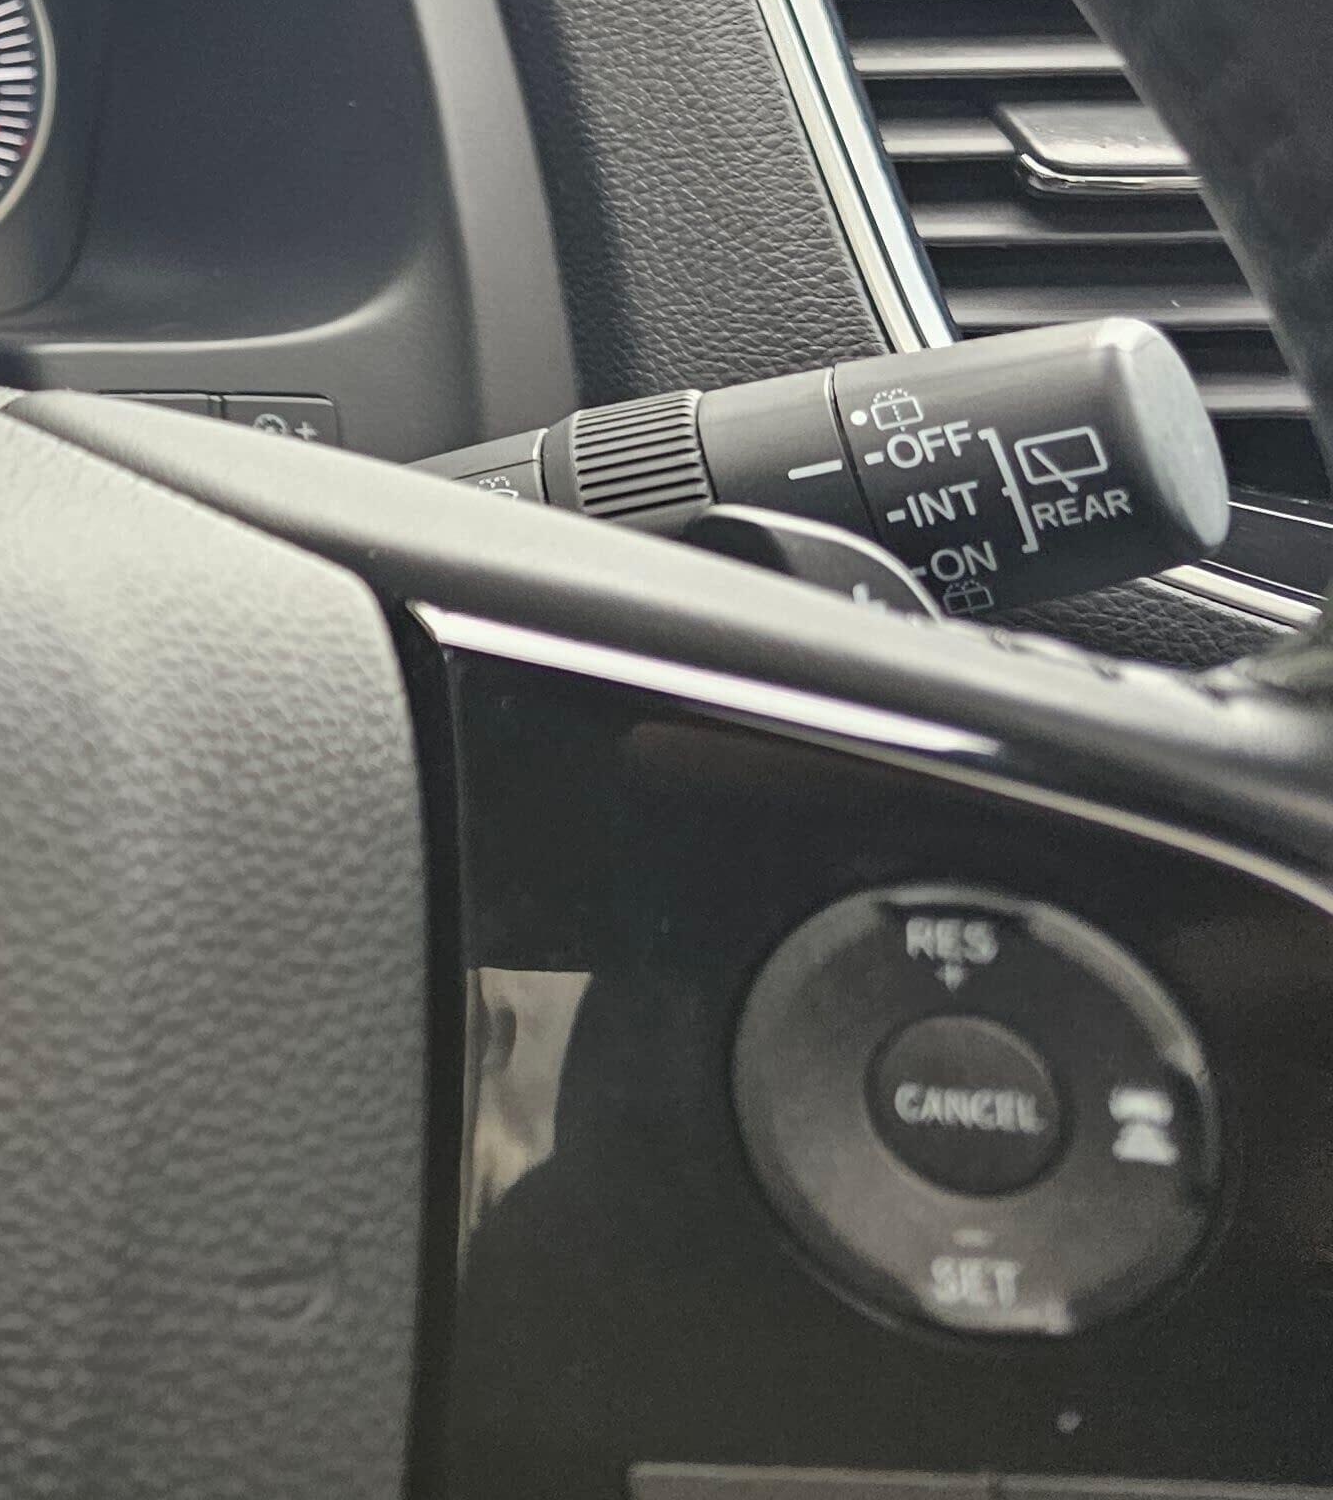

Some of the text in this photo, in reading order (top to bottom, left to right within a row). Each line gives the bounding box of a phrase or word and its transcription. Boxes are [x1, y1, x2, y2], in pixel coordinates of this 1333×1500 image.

[887, 420, 972, 469] OFF
[906, 480, 979, 528] INT
[1031, 489, 1133, 530] REAR
[931, 541, 997, 581] ON
[905, 918, 999, 965] RES
[894, 1082, 1046, 1136] CANCEL
[931, 1256, 1020, 1306] SET
